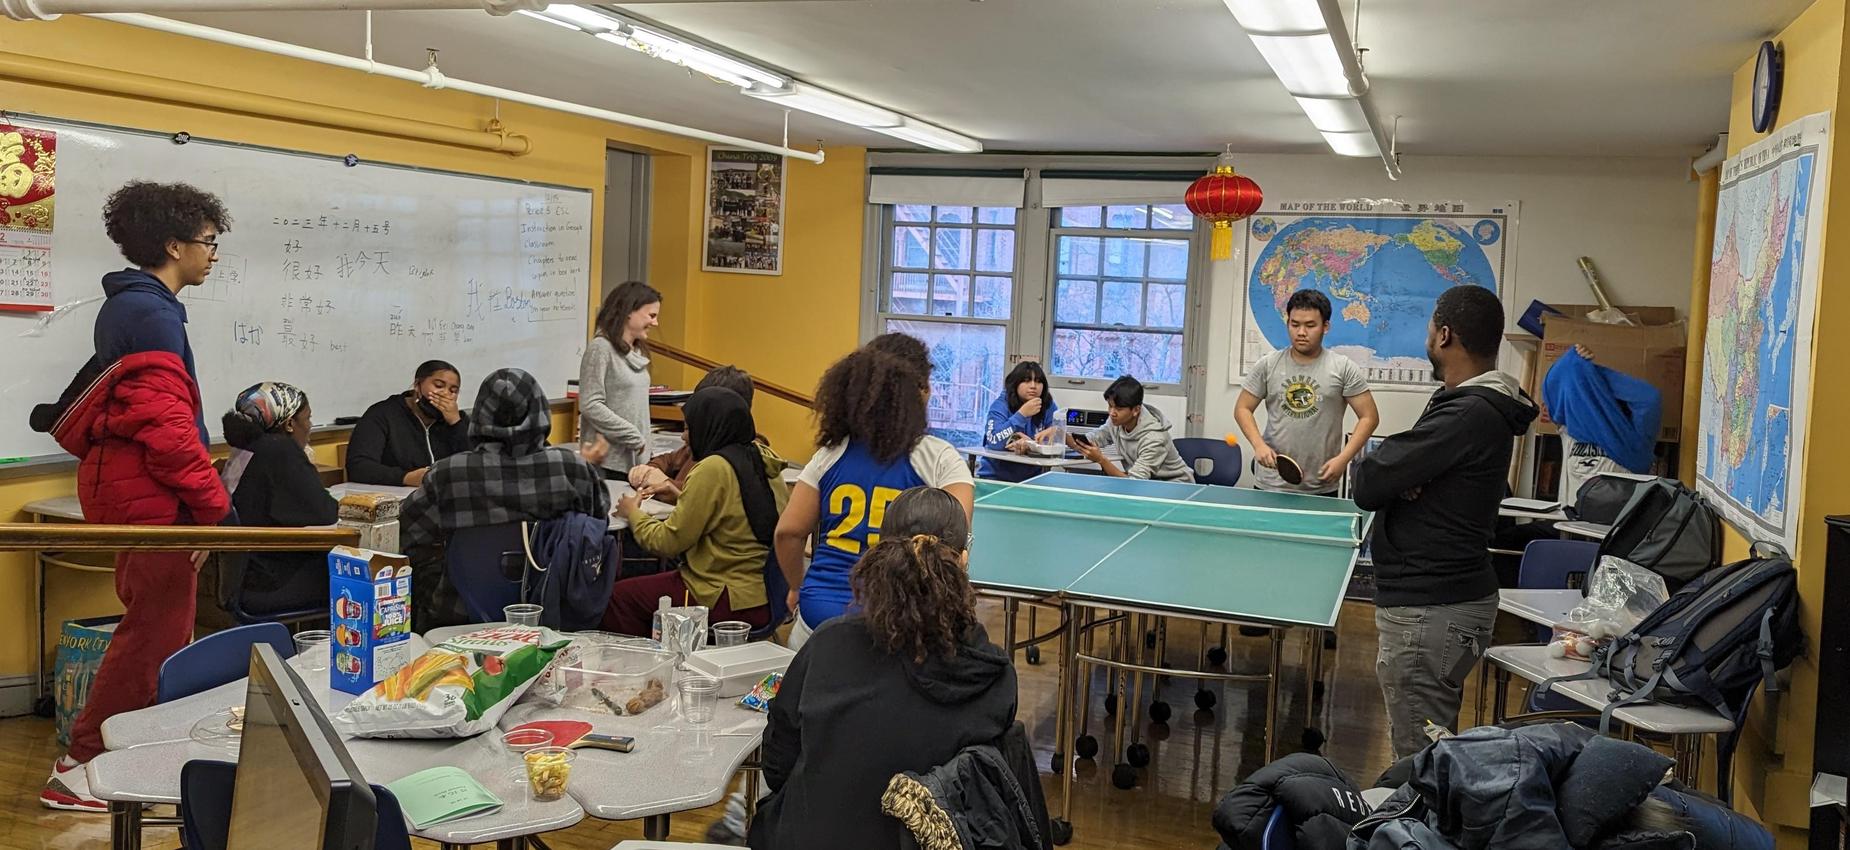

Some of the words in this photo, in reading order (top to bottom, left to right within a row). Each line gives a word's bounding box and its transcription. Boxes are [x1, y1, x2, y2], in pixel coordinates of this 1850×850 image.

[743, 152, 758, 161] Trip
[1280, 203, 1300, 211] MAP
[1303, 203, 1315, 211] OF
[1317, 203, 1337, 211] THE
[1339, 203, 1373, 212] WORLD
[284, 240, 303, 253] 好
[282, 259, 324, 280] 很好
[996, 426, 1014, 441] FISH
[383, 617, 404, 627] JUICE
